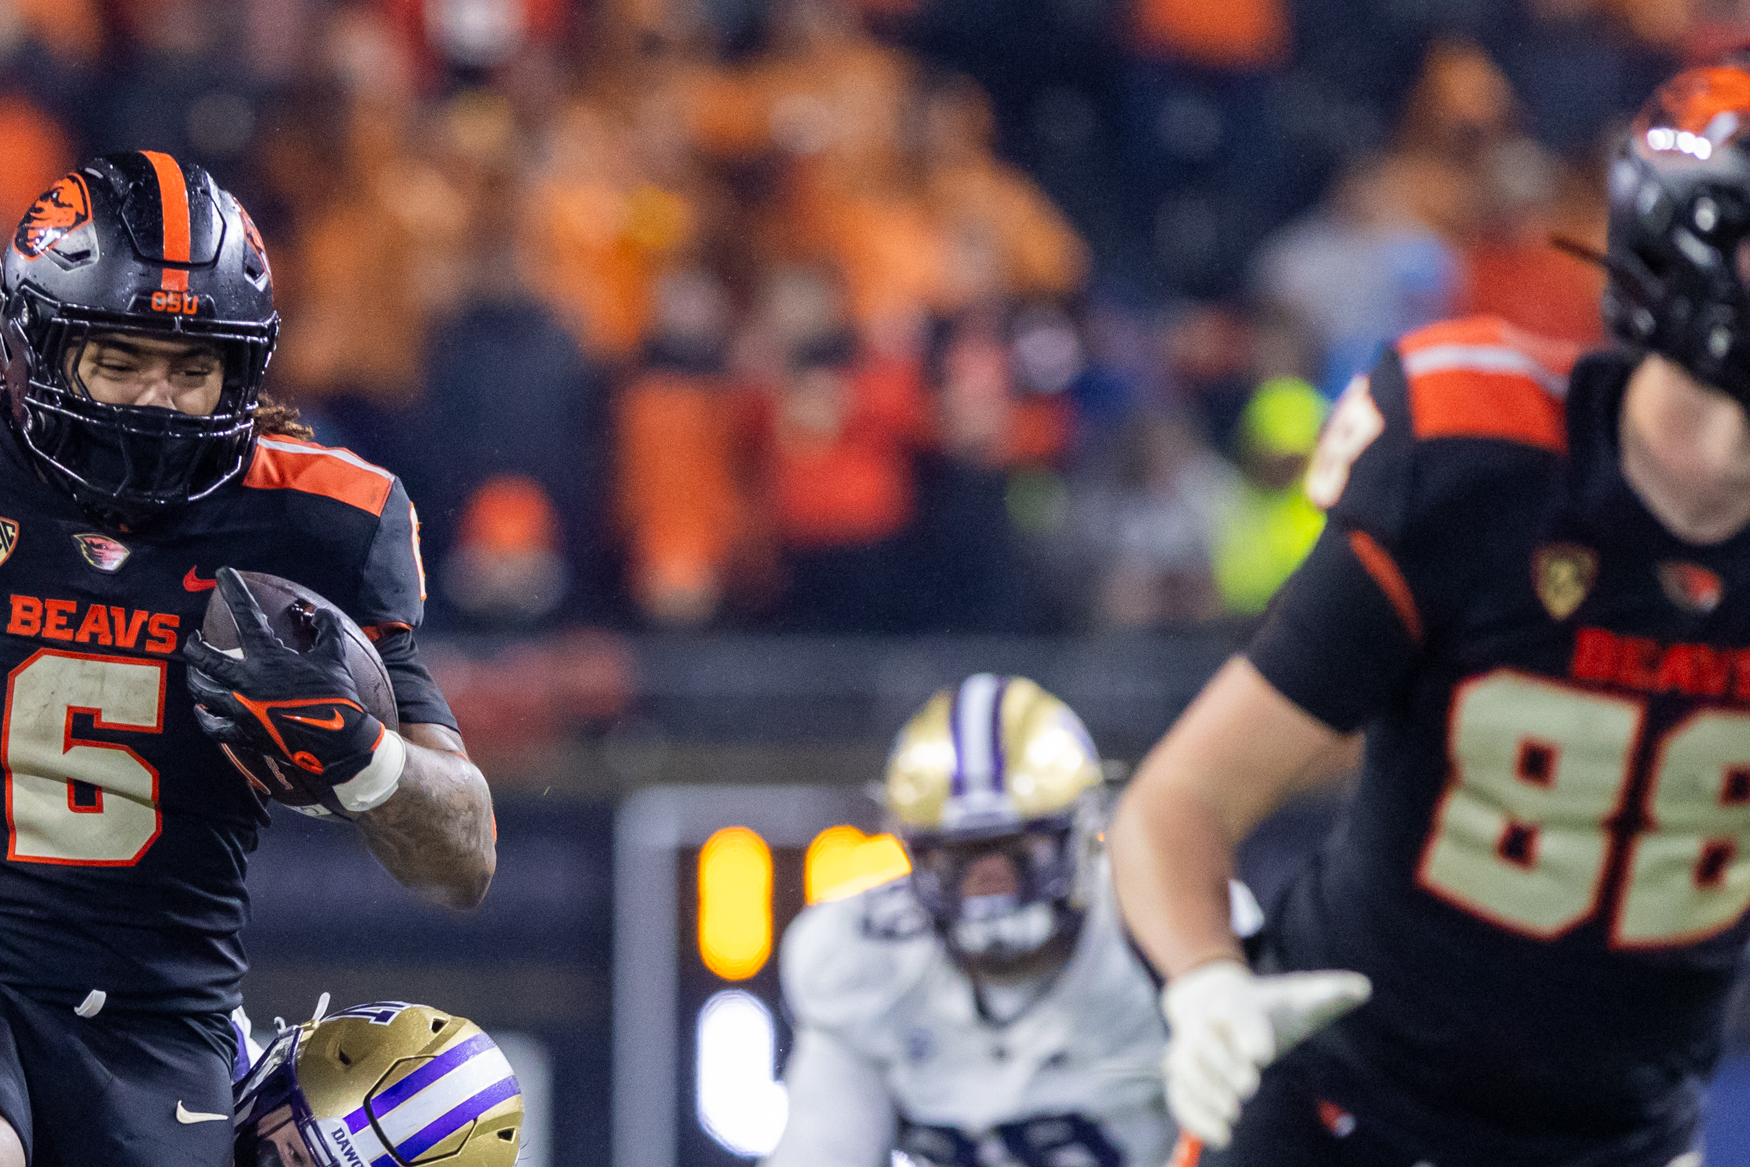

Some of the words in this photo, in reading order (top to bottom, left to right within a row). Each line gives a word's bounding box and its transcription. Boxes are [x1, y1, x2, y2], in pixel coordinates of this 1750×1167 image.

[151, 291, 199, 315] OSU
[6, 594, 180, 654] BEAVS
[0, 647, 168, 867] 6
[1415, 668, 1750, 950] 88
